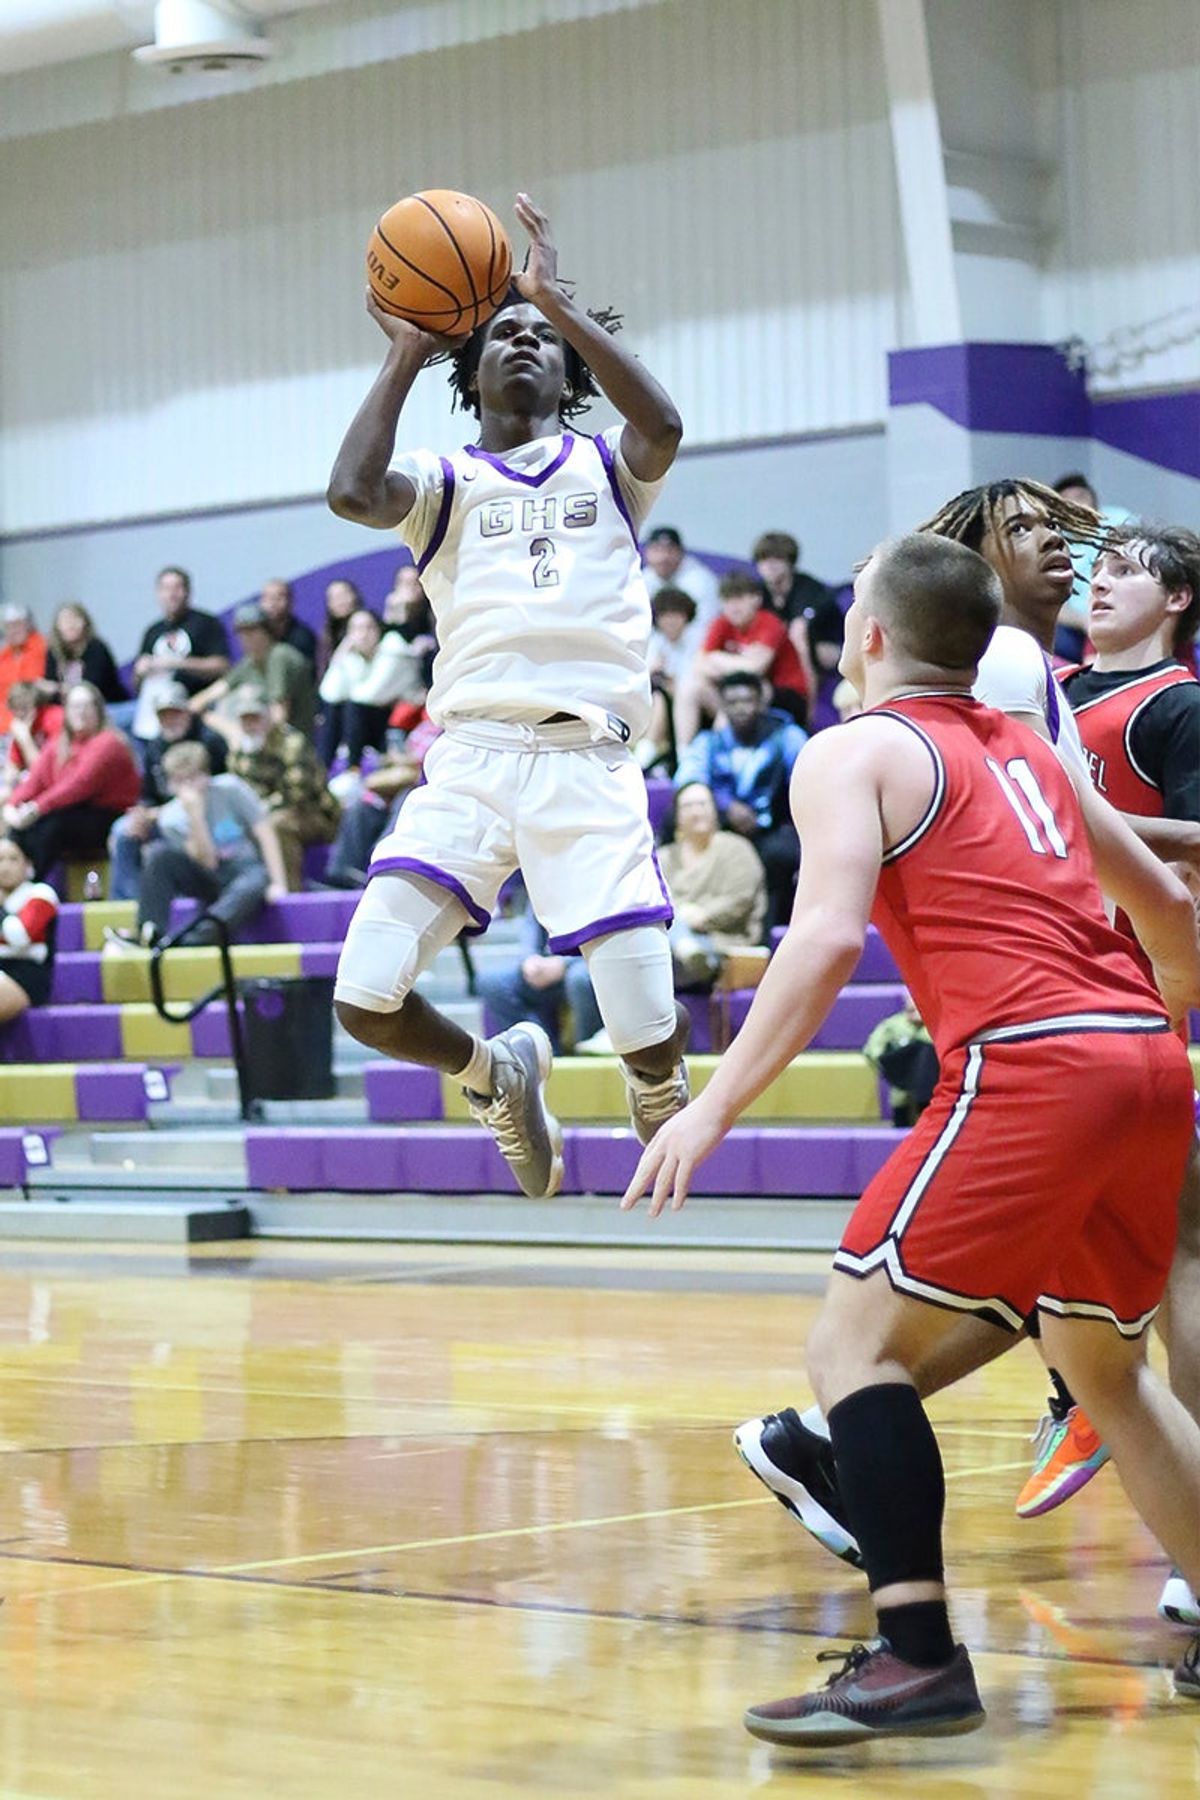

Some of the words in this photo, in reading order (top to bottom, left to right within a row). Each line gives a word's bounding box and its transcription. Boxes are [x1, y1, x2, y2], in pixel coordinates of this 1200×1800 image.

[480, 492, 598, 538] GHS
[529, 537, 559, 588] 2
[1082, 744, 1108, 793] EL
[984, 756, 1069, 860] 11
